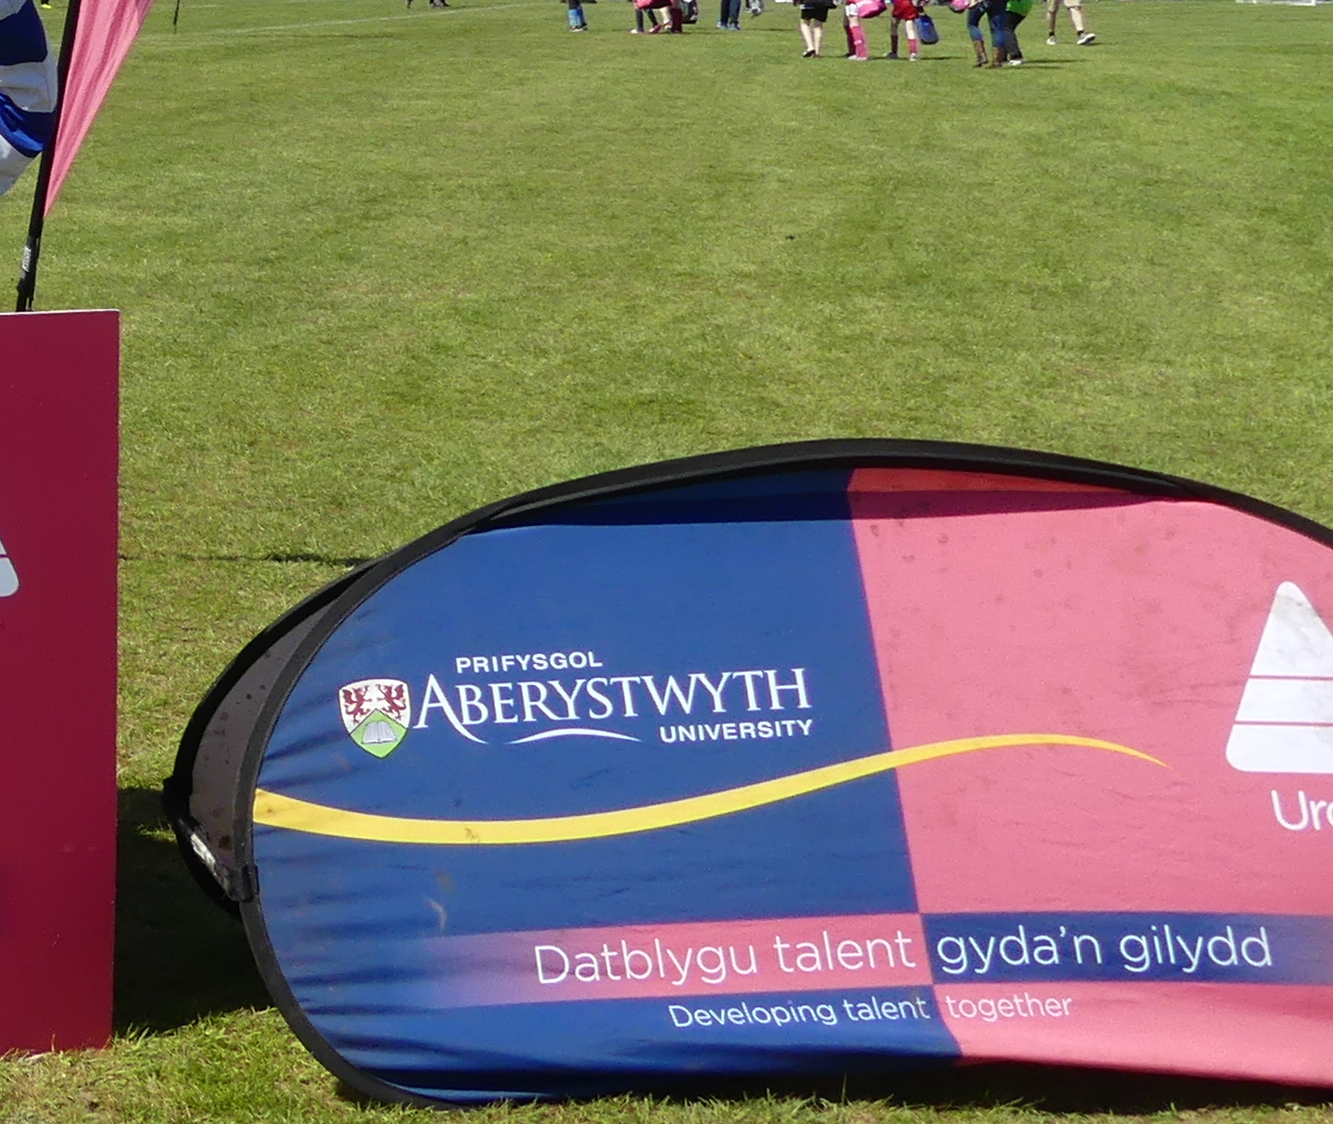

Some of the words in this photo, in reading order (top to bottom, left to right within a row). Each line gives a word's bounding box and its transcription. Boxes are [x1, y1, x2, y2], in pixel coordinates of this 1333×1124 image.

[455, 651, 604, 674] PRIFYSGOL
[412, 667, 813, 745] ABERYSTWYTH
[659, 718, 814, 743] UNIVERSITY
[1271, 789, 1333, 831] Ur
[534, 937, 758, 986] Datblygu
[773, 930, 916, 973] talent
[937, 924, 1102, 975] gyda'n
[1119, 924, 1273, 973] gilydd
[668, 1001, 838, 1027] Developing
[842, 995, 931, 1021] talent
[945, 992, 1072, 1023] together
